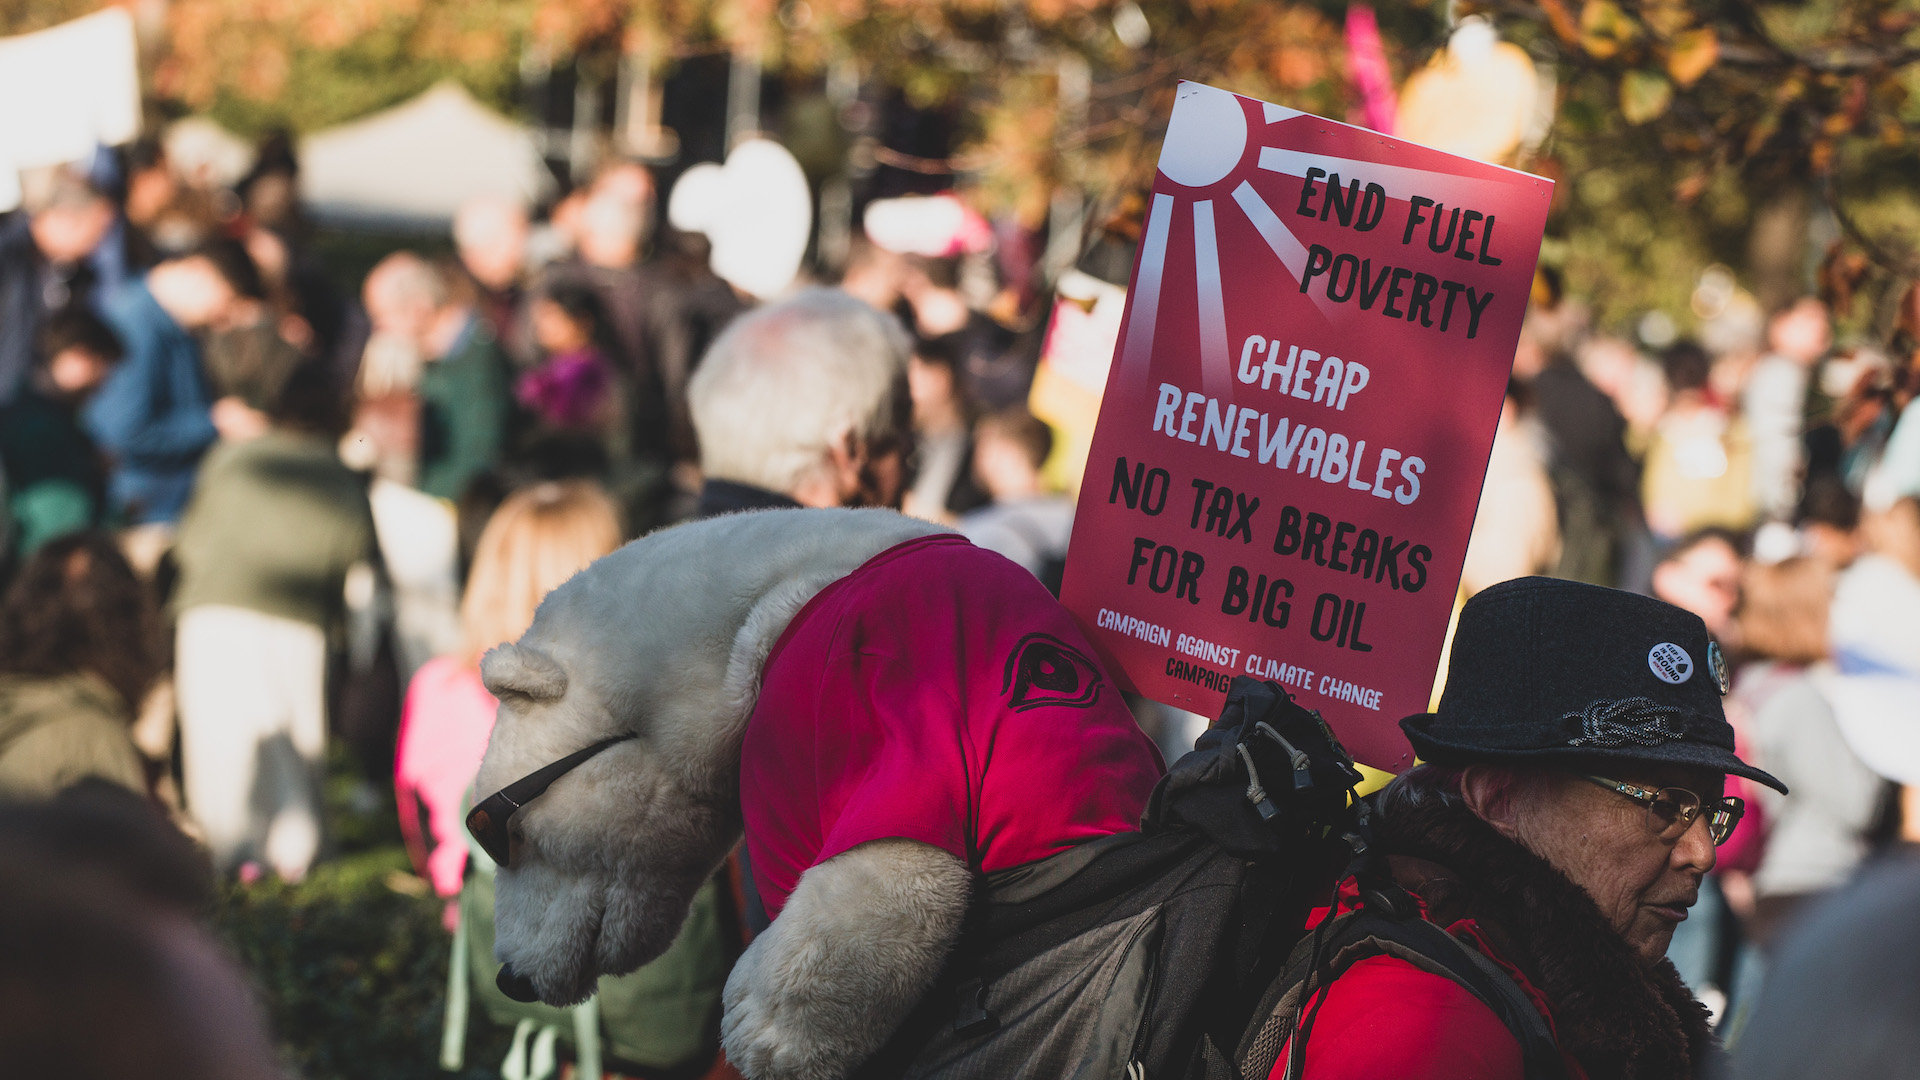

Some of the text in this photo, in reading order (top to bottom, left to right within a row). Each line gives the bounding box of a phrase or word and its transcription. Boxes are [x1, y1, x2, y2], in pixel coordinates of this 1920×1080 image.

[1296, 166, 1503, 267] END FUEL
[1299, 243, 1495, 339] POVERTY
[1237, 334, 1370, 411] CHEAP
[1152, 382, 1427, 506] RENEWABLES
[1108, 456, 1433, 593] NO TAX BREAKS
[1127, 536, 1373, 652] FOR BIG OIL
[1096, 607, 1384, 711] CAMPAIGN AGAINST CLIMATE CHANGE
[1652, 651, 1680, 681] GROUND
[1665, 653, 1676, 664] THE
[1666, 643, 1679, 655] KEEP
